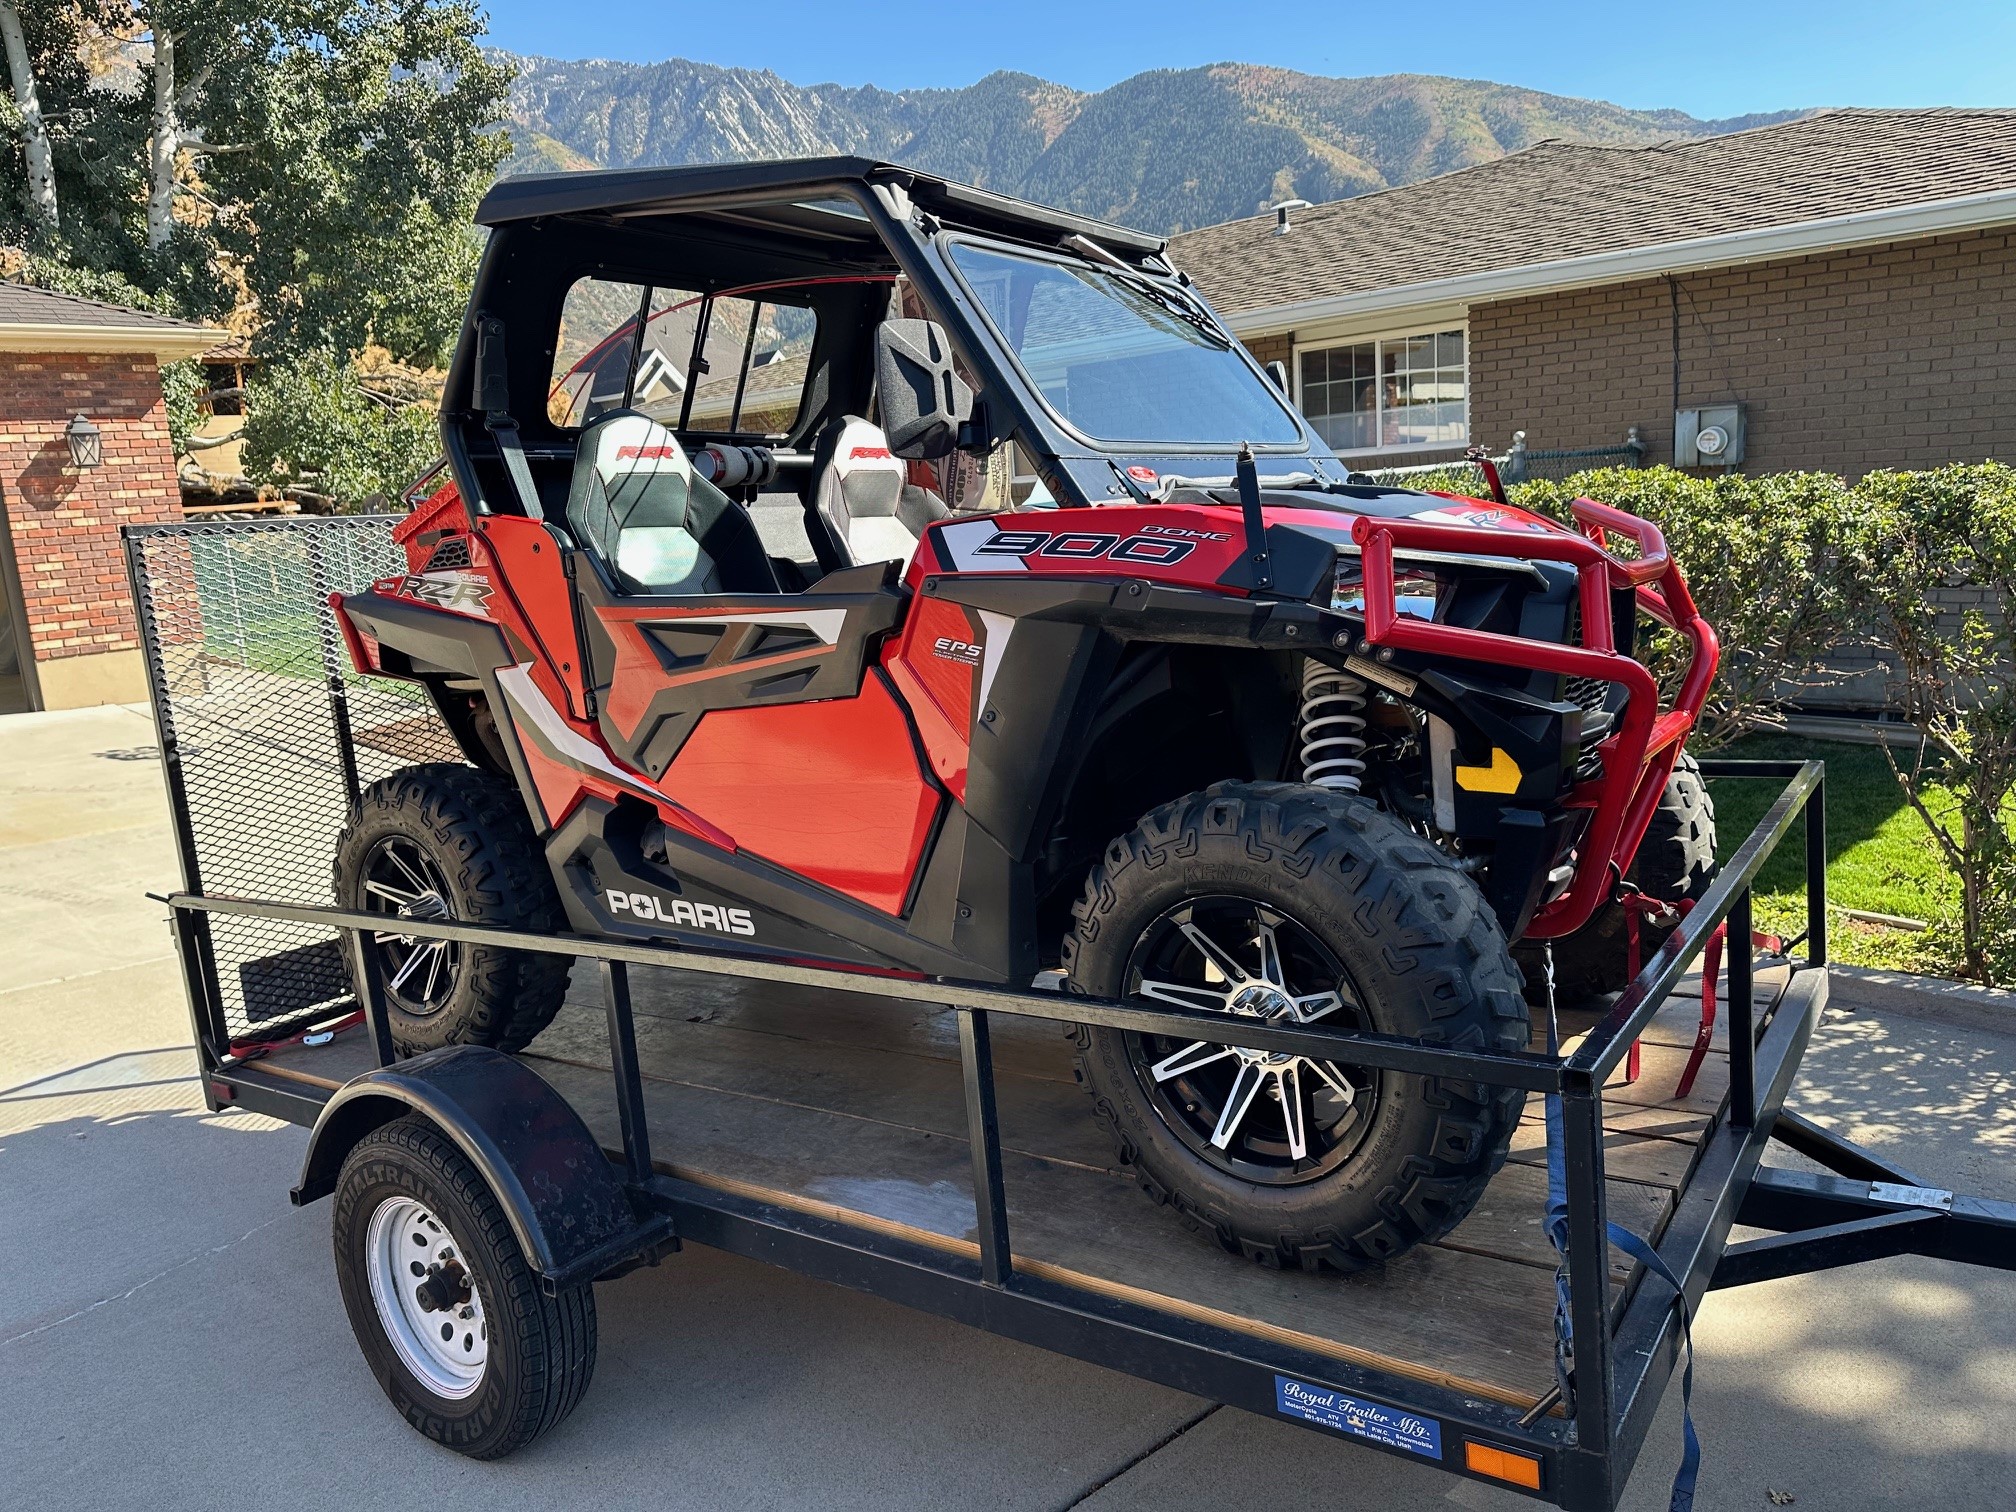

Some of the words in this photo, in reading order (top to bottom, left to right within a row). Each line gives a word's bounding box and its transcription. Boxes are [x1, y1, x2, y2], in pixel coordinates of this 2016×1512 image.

[615, 446, 674, 461] RZR
[849, 446, 891, 460] RZR
[956, 468, 967, 503] 100
[971, 530, 1198, 567] 900
[1139, 525, 1233, 542] DOHC
[396, 575, 496, 610] RZR
[457, 572, 489, 584] POLARIS
[934, 637, 983, 657] EPS
[1183, 864, 1272, 890] KENDA
[605, 888, 756, 936] POLARIS
[396, 1379, 501, 1442] CARLISLE
[1284, 1382, 1334, 1406] Royal
[1338, 1399, 1390, 1423] Trailer
[1392, 1416, 1431, 1438] Mfg.
[1327, 1413, 1340, 1421] ATV
[1395, 1433, 1434, 1450] Snowmobile
[1353, 1427, 1366, 1436] Salt
[1366, 1431, 1381, 1441] Lake
[1397, 1440, 1412, 1450] Utah
